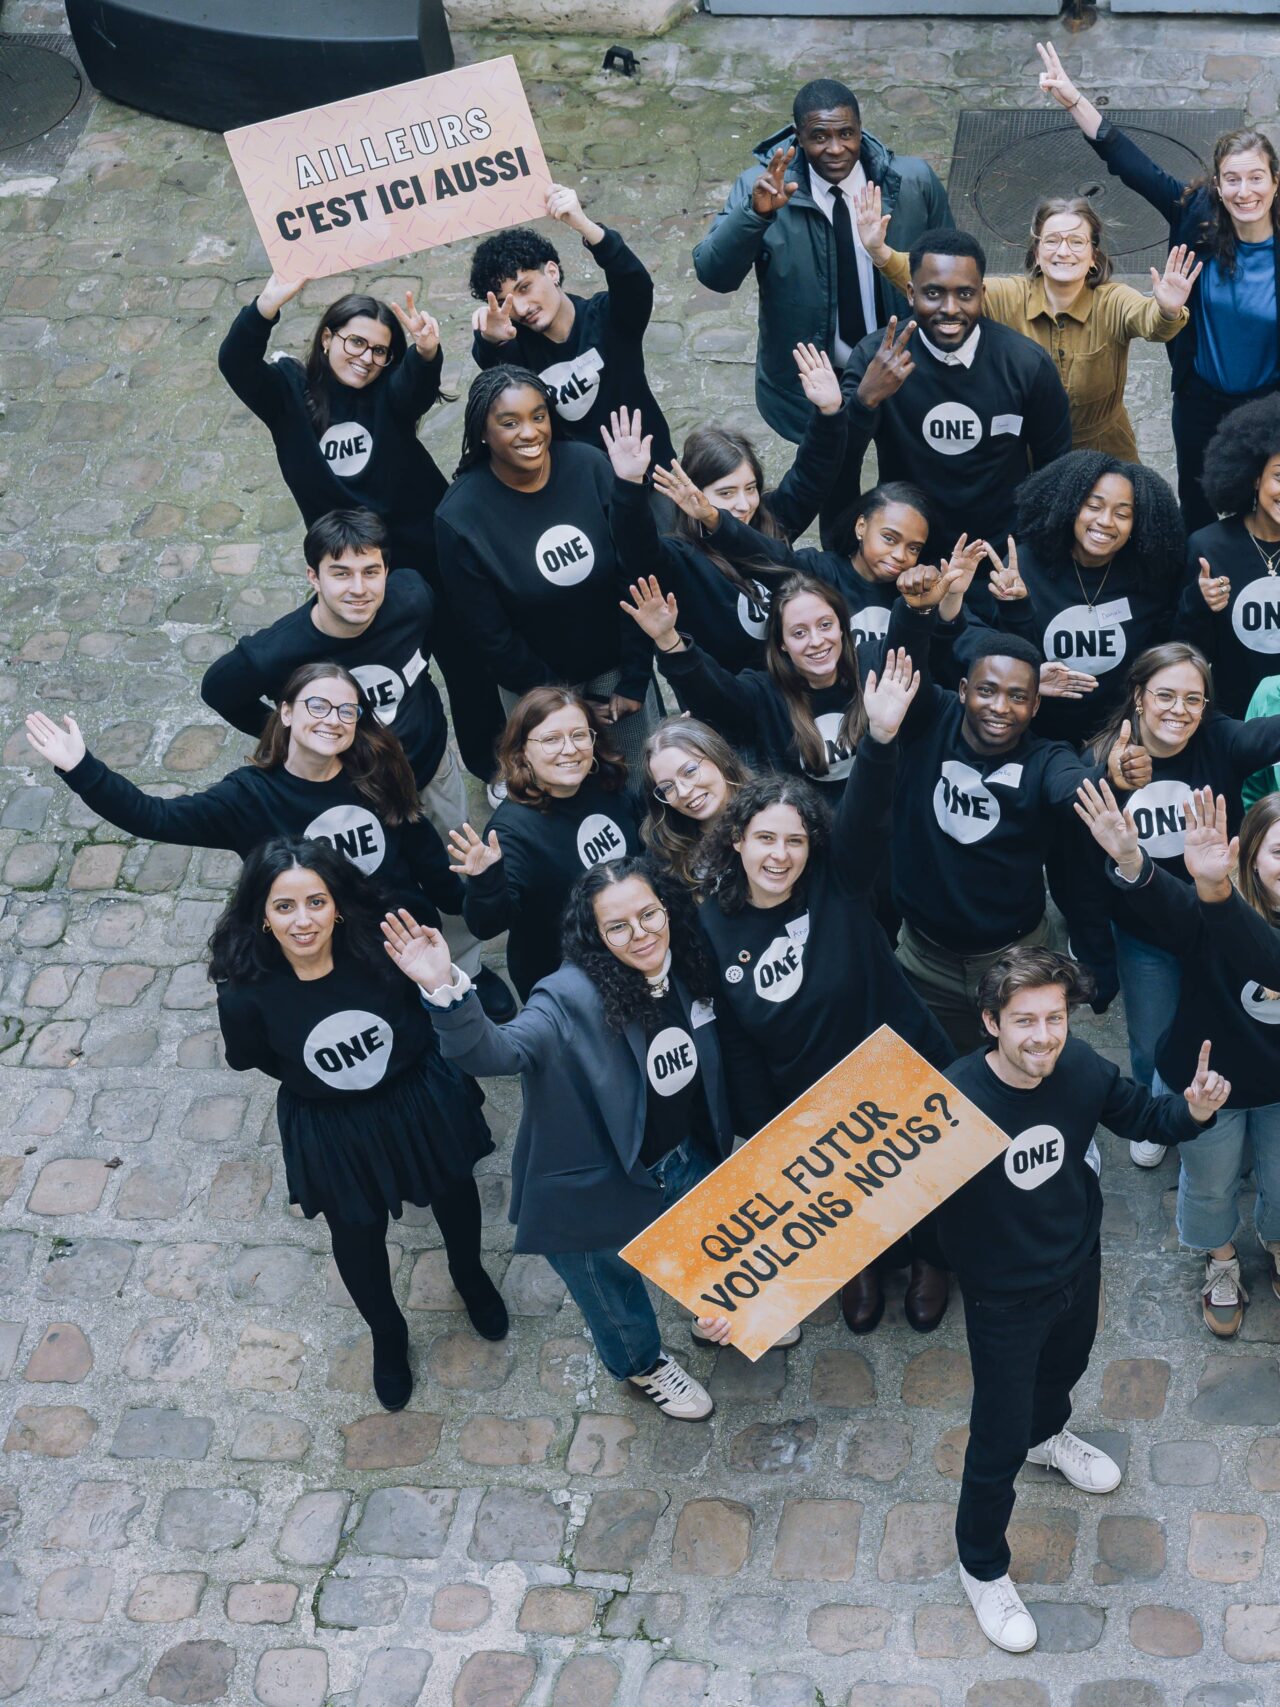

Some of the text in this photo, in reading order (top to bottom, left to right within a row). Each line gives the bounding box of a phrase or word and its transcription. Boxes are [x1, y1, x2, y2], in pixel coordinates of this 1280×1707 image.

[296, 107, 492, 190] AILLEURS
[275, 147, 532, 242] C'EST ICI AUSSI
[324, 434, 368, 461] ONE
[929, 419, 975, 440] ONE
[542, 535, 589, 572] ONE
[1053, 629, 1117, 658] ONE
[584, 824, 621, 864] ONE
[760, 945, 800, 988] ONE
[314, 1025, 385, 1074] ONE
[653, 1042, 693, 1082] ONE
[1012, 1138, 1059, 1174] ONE
[702, 1100, 898, 1263] QUEL FUTUR
[701, 1191, 854, 1312] VOULONS
